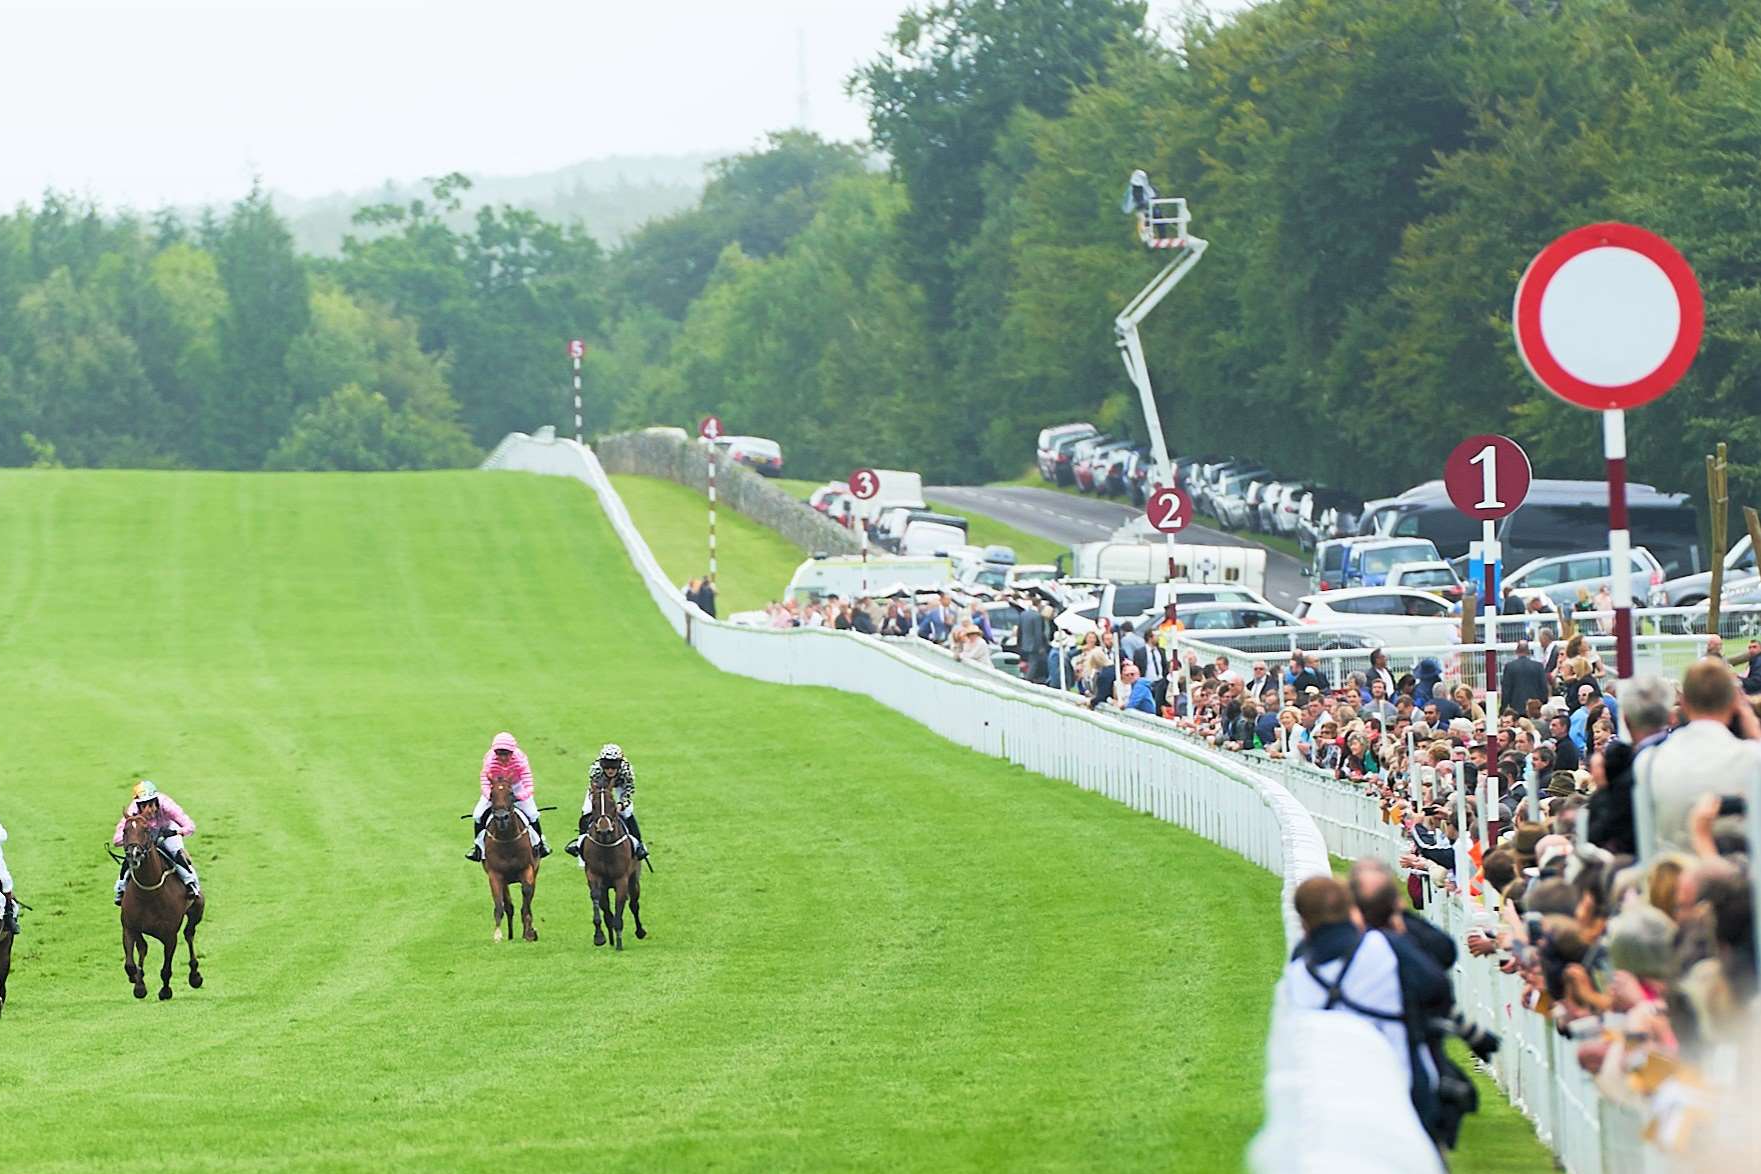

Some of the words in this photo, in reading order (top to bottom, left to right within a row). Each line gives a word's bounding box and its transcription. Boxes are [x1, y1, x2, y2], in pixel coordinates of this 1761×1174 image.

[704, 419, 718, 438] 4
[856, 472, 874, 498] 3
[1469, 445, 1506, 510] 1
[1158, 494, 1182, 530] 2
